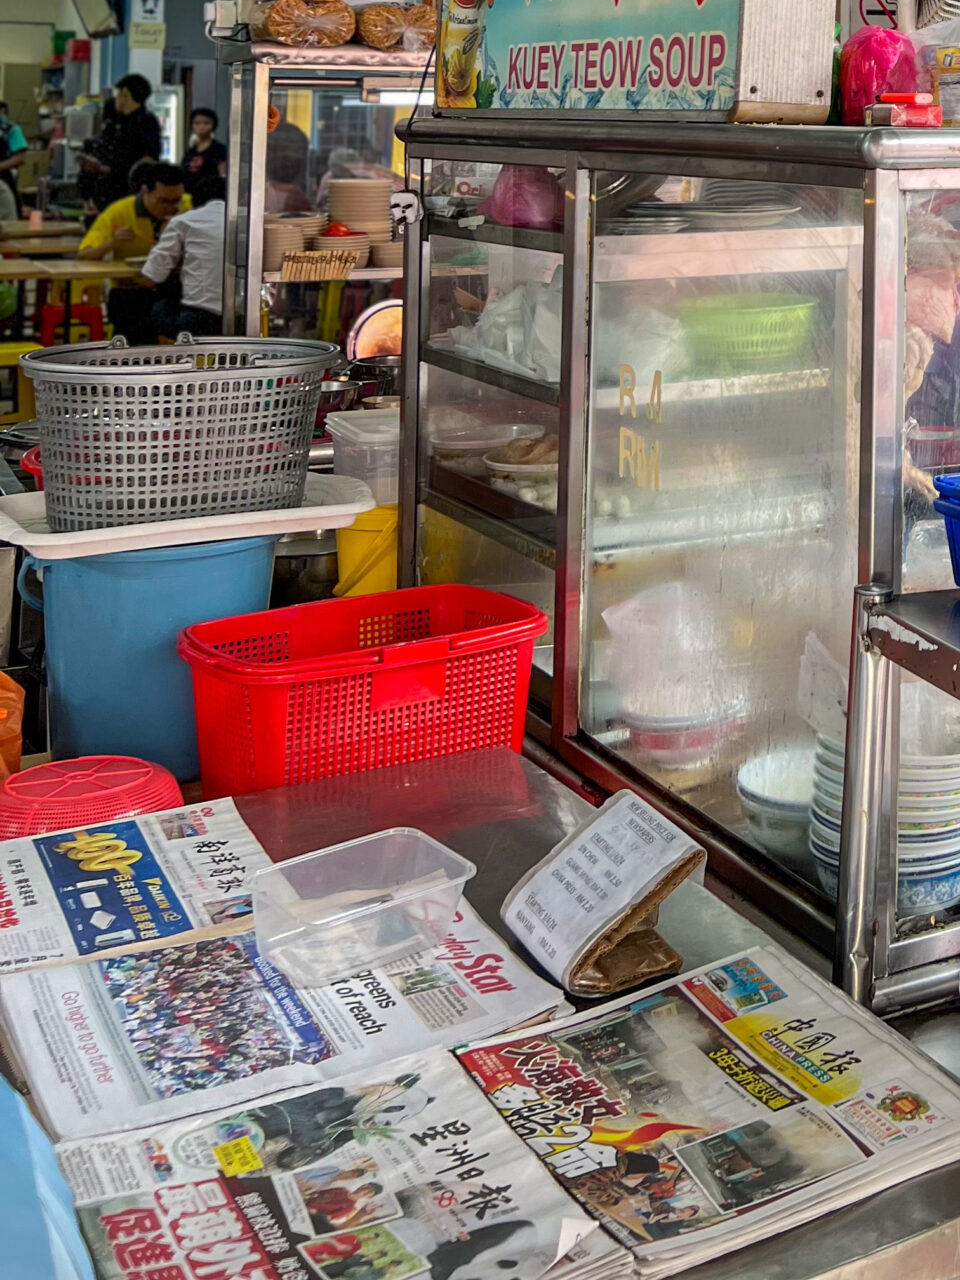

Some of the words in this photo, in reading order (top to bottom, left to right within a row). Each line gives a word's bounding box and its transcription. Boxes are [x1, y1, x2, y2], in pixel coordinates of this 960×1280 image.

[507, 44, 564, 90] KUEY
[571, 39, 642, 89] TEOW
[648, 33, 726, 88] SOUP
[626, 817, 656, 844] NEWSPAPERS
[627, 800, 641, 813] NEW
[637, 808, 656, 826] SELLING
[652, 821, 667, 834] PRICE
[663, 830, 676, 842] FOR
[590, 831, 614, 853] STARTING
[147, 884, 171, 910] DAIKIN
[561, 879, 576, 895] PRESS
[267, 973, 286, 988] for
[455, 953, 517, 995] Star
[61, 991, 79, 1006] Go
[273, 983, 291, 999] the
[334, 982, 360, 1001] of
[352, 969, 397, 1010] greens
[65, 1004, 90, 1032] higher
[279, 995, 308, 1028] weekend
[343, 995, 388, 1037] reach
[78, 1031, 94, 1042] to
[78, 1042, 100, 1055] go
[88, 1054, 115, 1083] further
[761, 1031, 796, 1058] CHINA
[795, 1056, 832, 1082] PRESS
[160, 1182, 263, 1280] 最萌外
